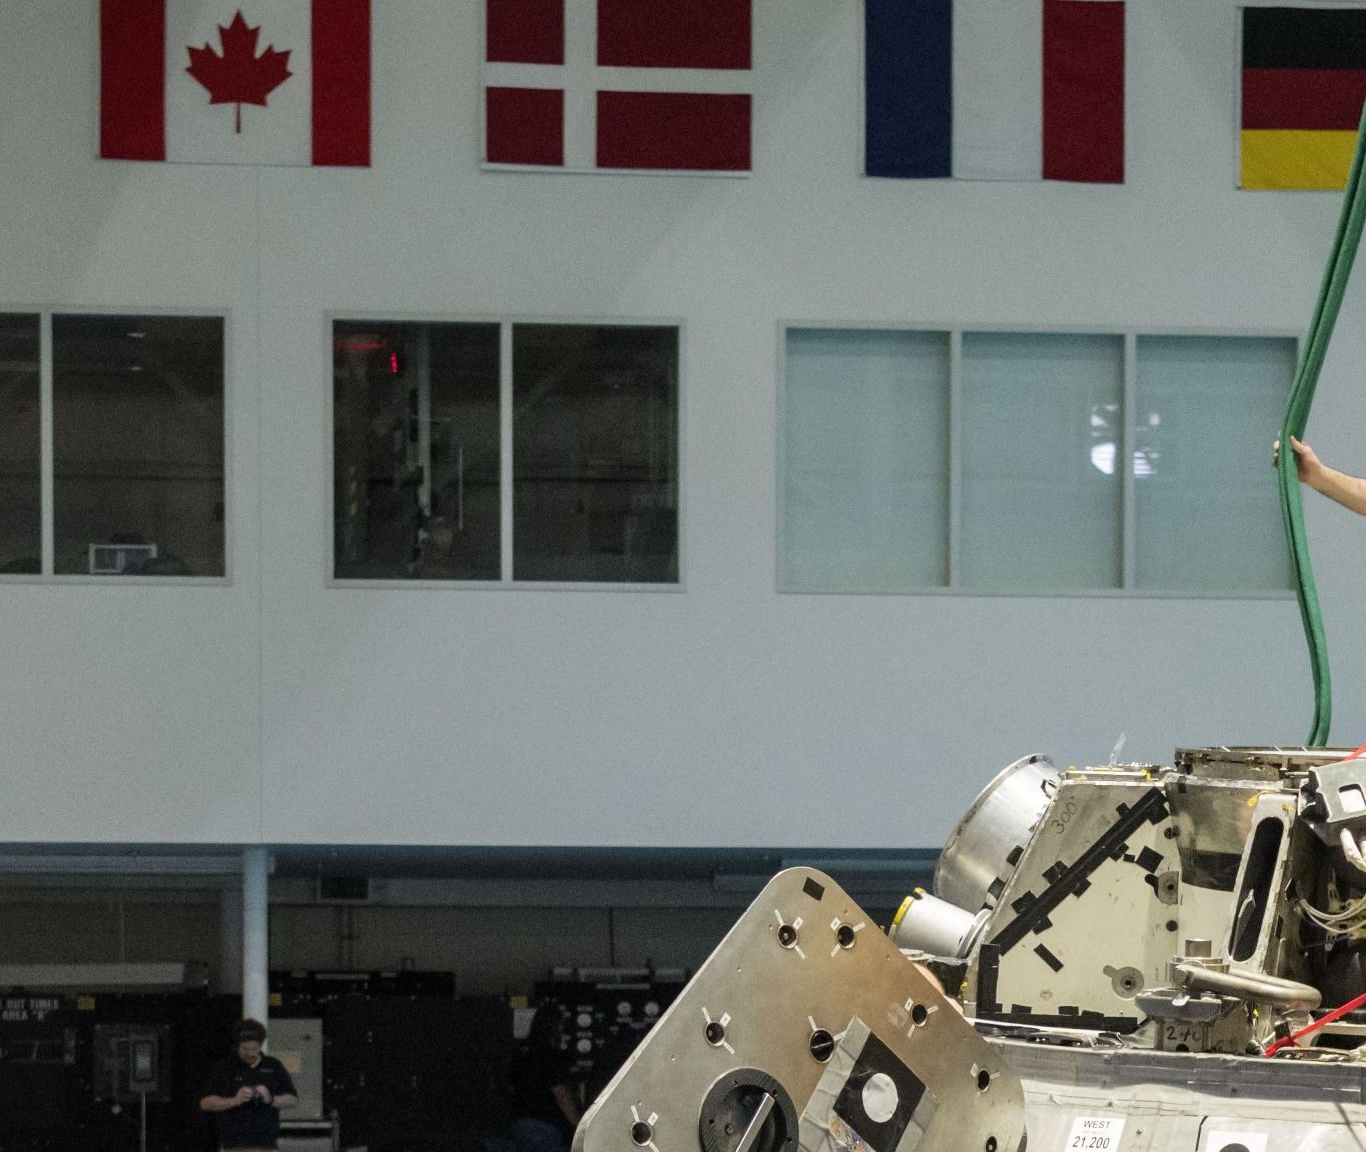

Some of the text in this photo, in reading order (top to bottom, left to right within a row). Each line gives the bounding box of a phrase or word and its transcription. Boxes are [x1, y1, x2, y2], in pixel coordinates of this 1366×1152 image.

[6, 998, 26, 1010] OUT
[29, 998, 60, 1010] TIMES
[1, 1009, 29, 1021] AREA
[1083, 1120, 1111, 1129] WEST
[1071, 1135, 1110, 1150] 21,200
